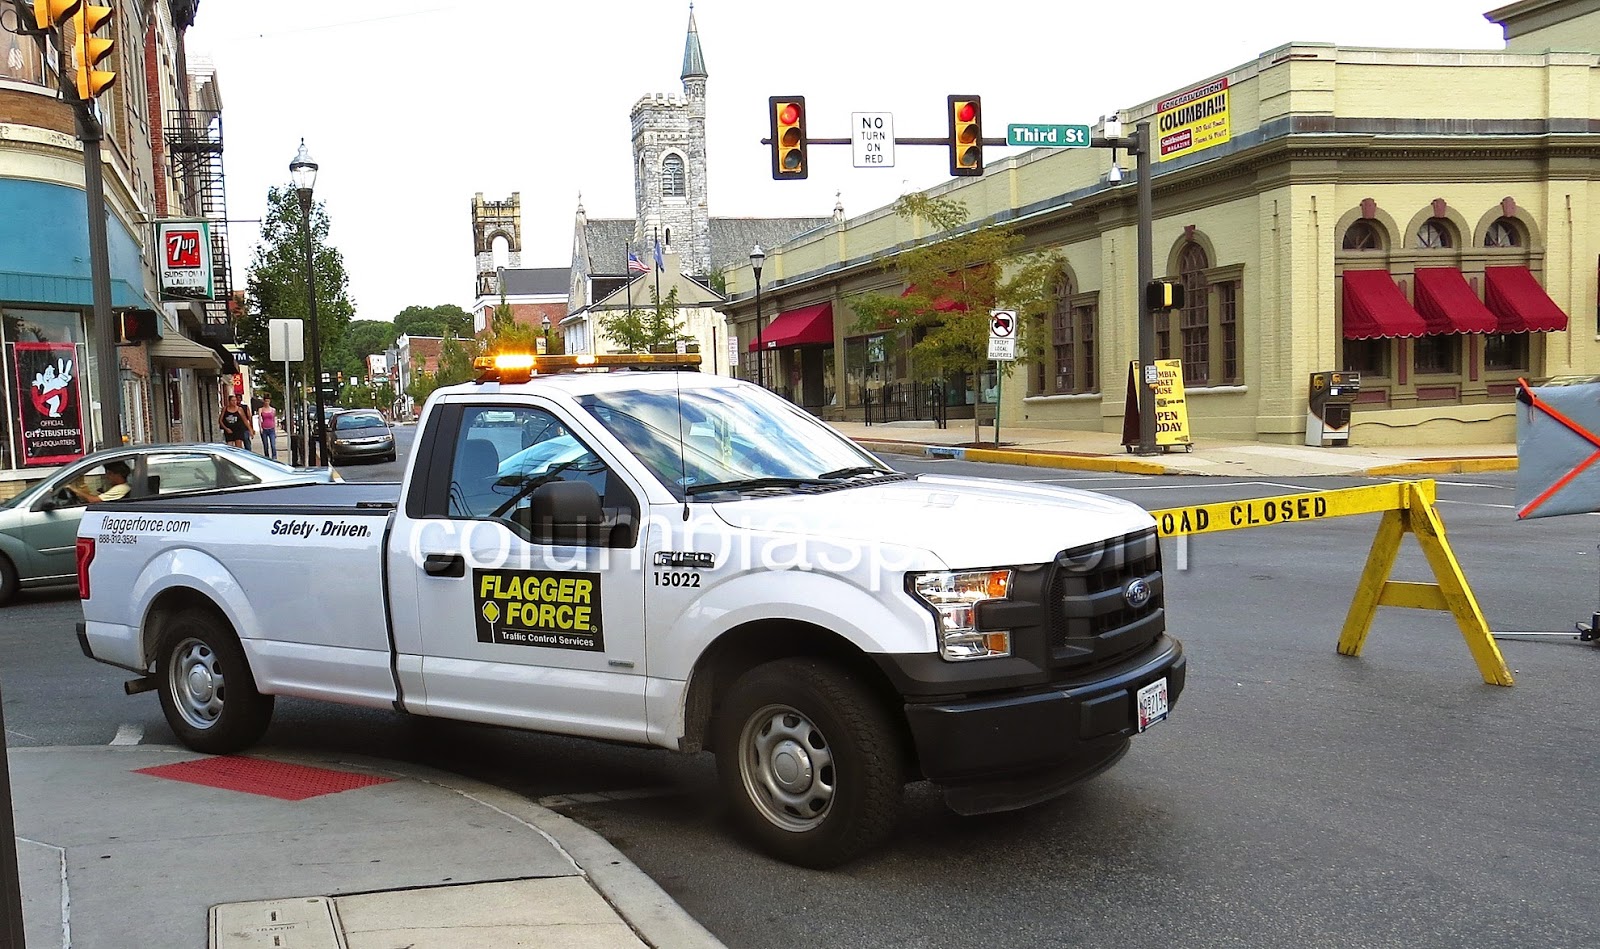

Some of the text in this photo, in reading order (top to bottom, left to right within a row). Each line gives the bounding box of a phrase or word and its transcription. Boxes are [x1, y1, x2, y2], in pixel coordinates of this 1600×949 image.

[1160, 93, 1226, 132] COLUMBIA!!!
[862, 117, 883, 129] NO
[861, 131, 885, 140] TURN
[1013, 127, 1084, 143] Third St
[866, 142, 881, 152] ON
[865, 154, 883, 164] RED
[231, 352, 247, 361] TM
[1156, 411, 1178, 421] PEN
[1156, 422, 1182, 433] ODAY
[32, 439, 76, 448] HEADQUARTERS
[1152, 497, 1327, 535] OAD CLOSED
[101, 515, 191, 534] flaggerforce.com
[271, 519, 368, 539] Safety Driven
[99, 534, 137, 544] 888-312-3524
[654, 572, 701, 587] 15022
[480, 575, 593, 603] FLAGGER
[506, 602, 592, 630] FORCE
[502, 631, 594, 647] Traffic Control Services
